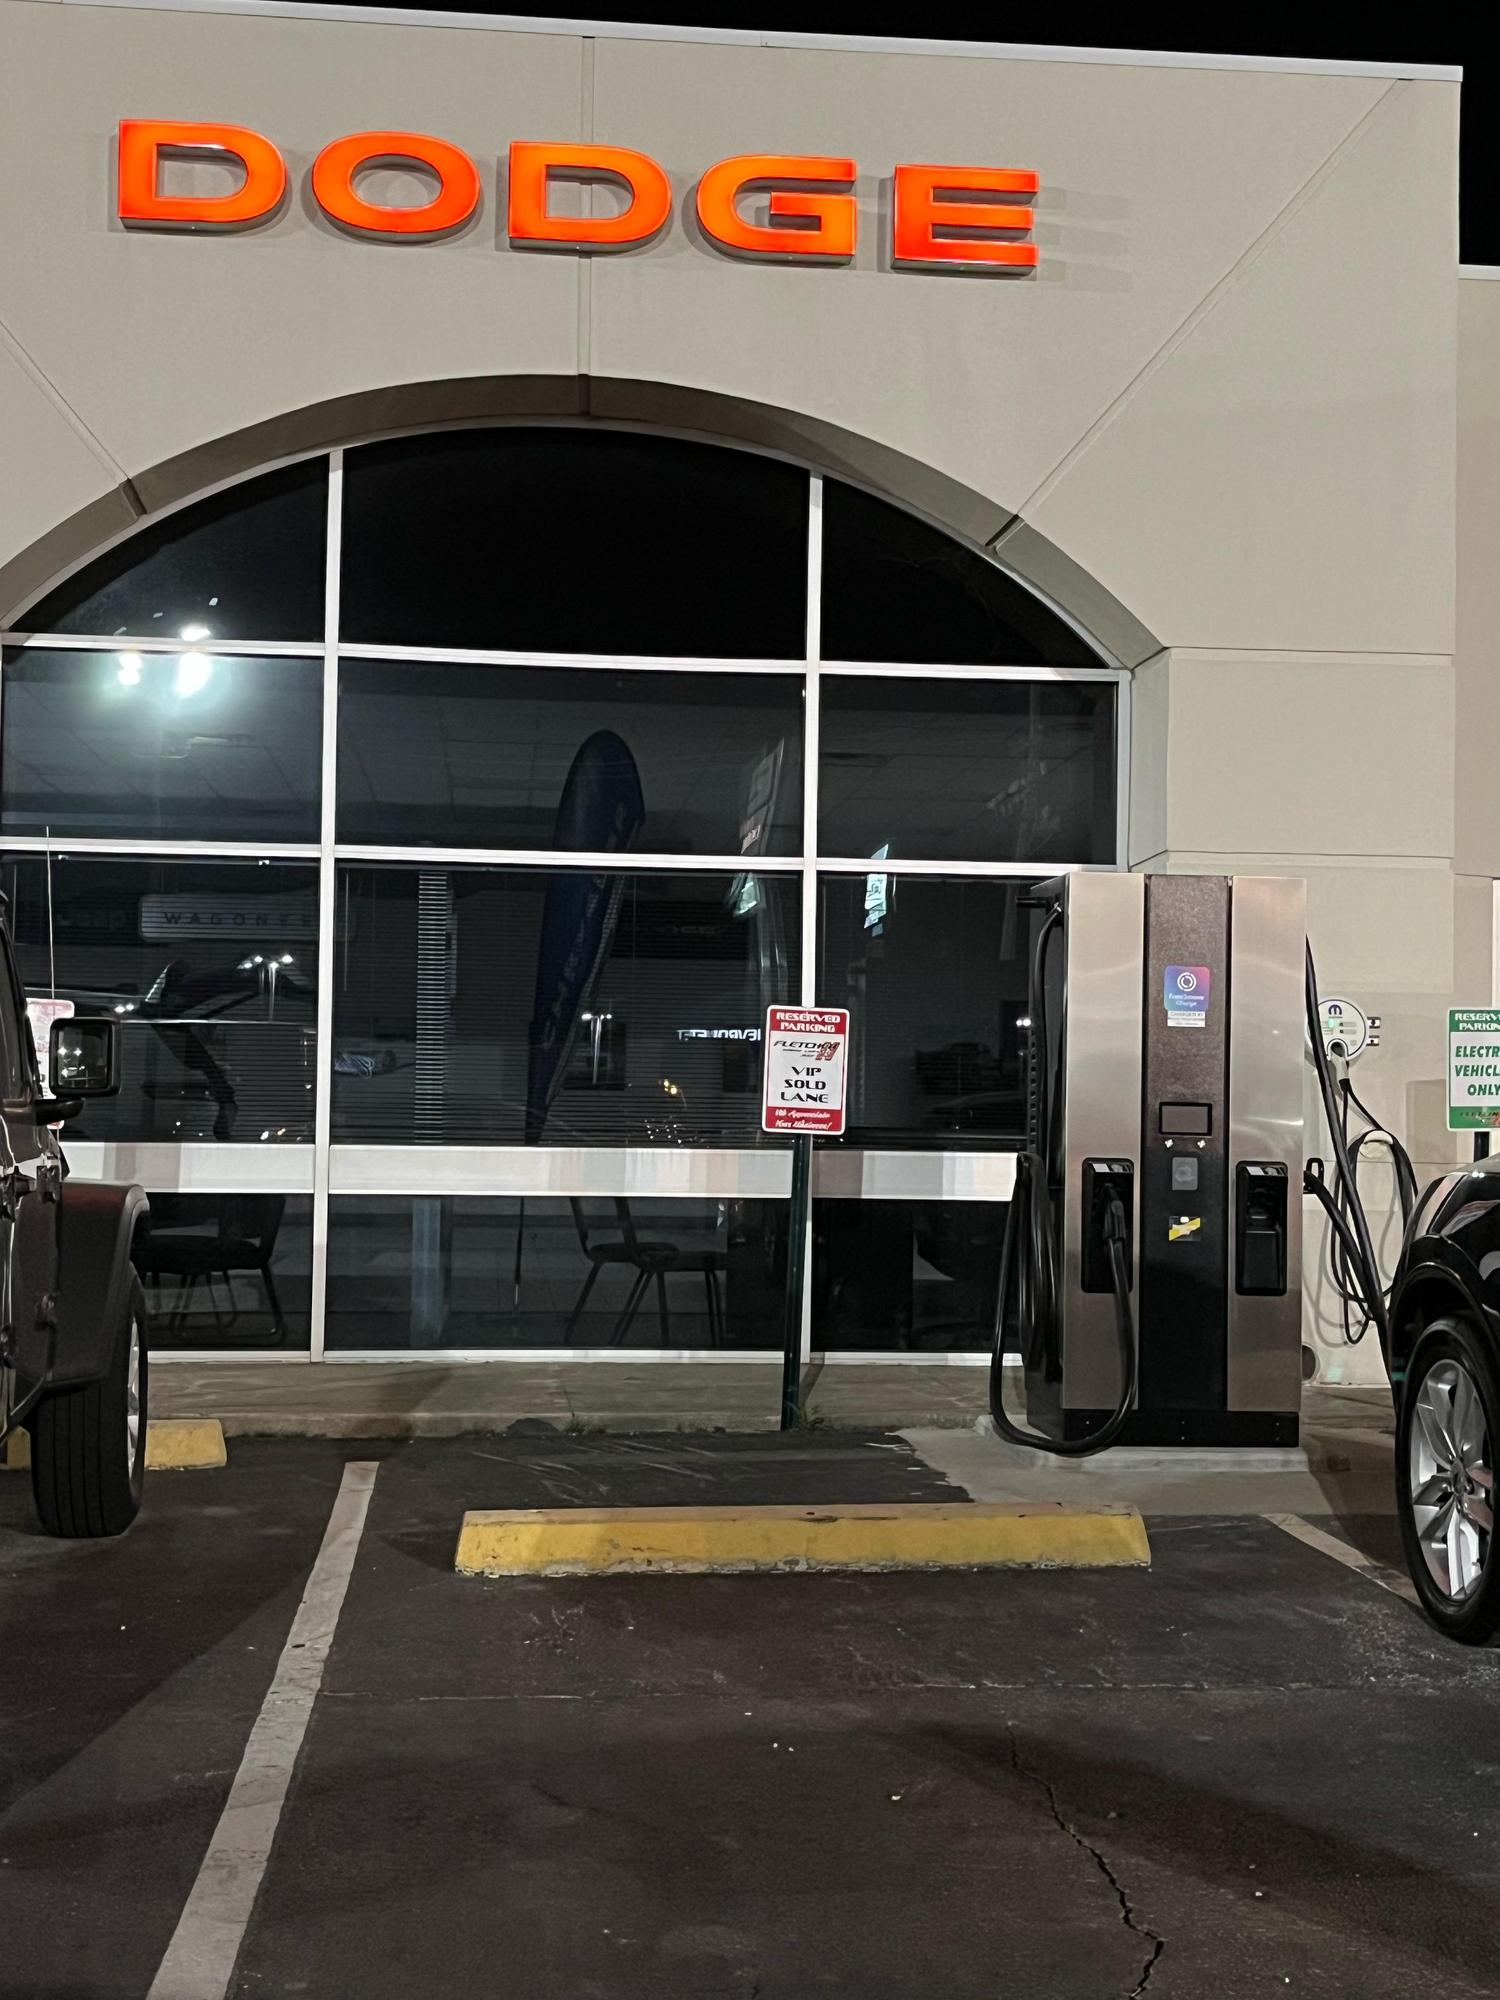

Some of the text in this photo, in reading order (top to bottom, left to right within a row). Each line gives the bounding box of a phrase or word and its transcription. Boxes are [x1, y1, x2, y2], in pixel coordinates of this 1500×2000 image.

[118, 119, 1039, 274] DODGE
[776, 1012, 840, 1023] RESERVED
[780, 1022, 835, 1032] PARKING
[791, 1066, 821, 1076] VIP
[784, 1079, 826, 1090] SOLD
[1467, 1084, 1500, 1096] ONLY
[780, 1092, 829, 1103] LANE
[788, 1110, 831, 1119] Appreciate
